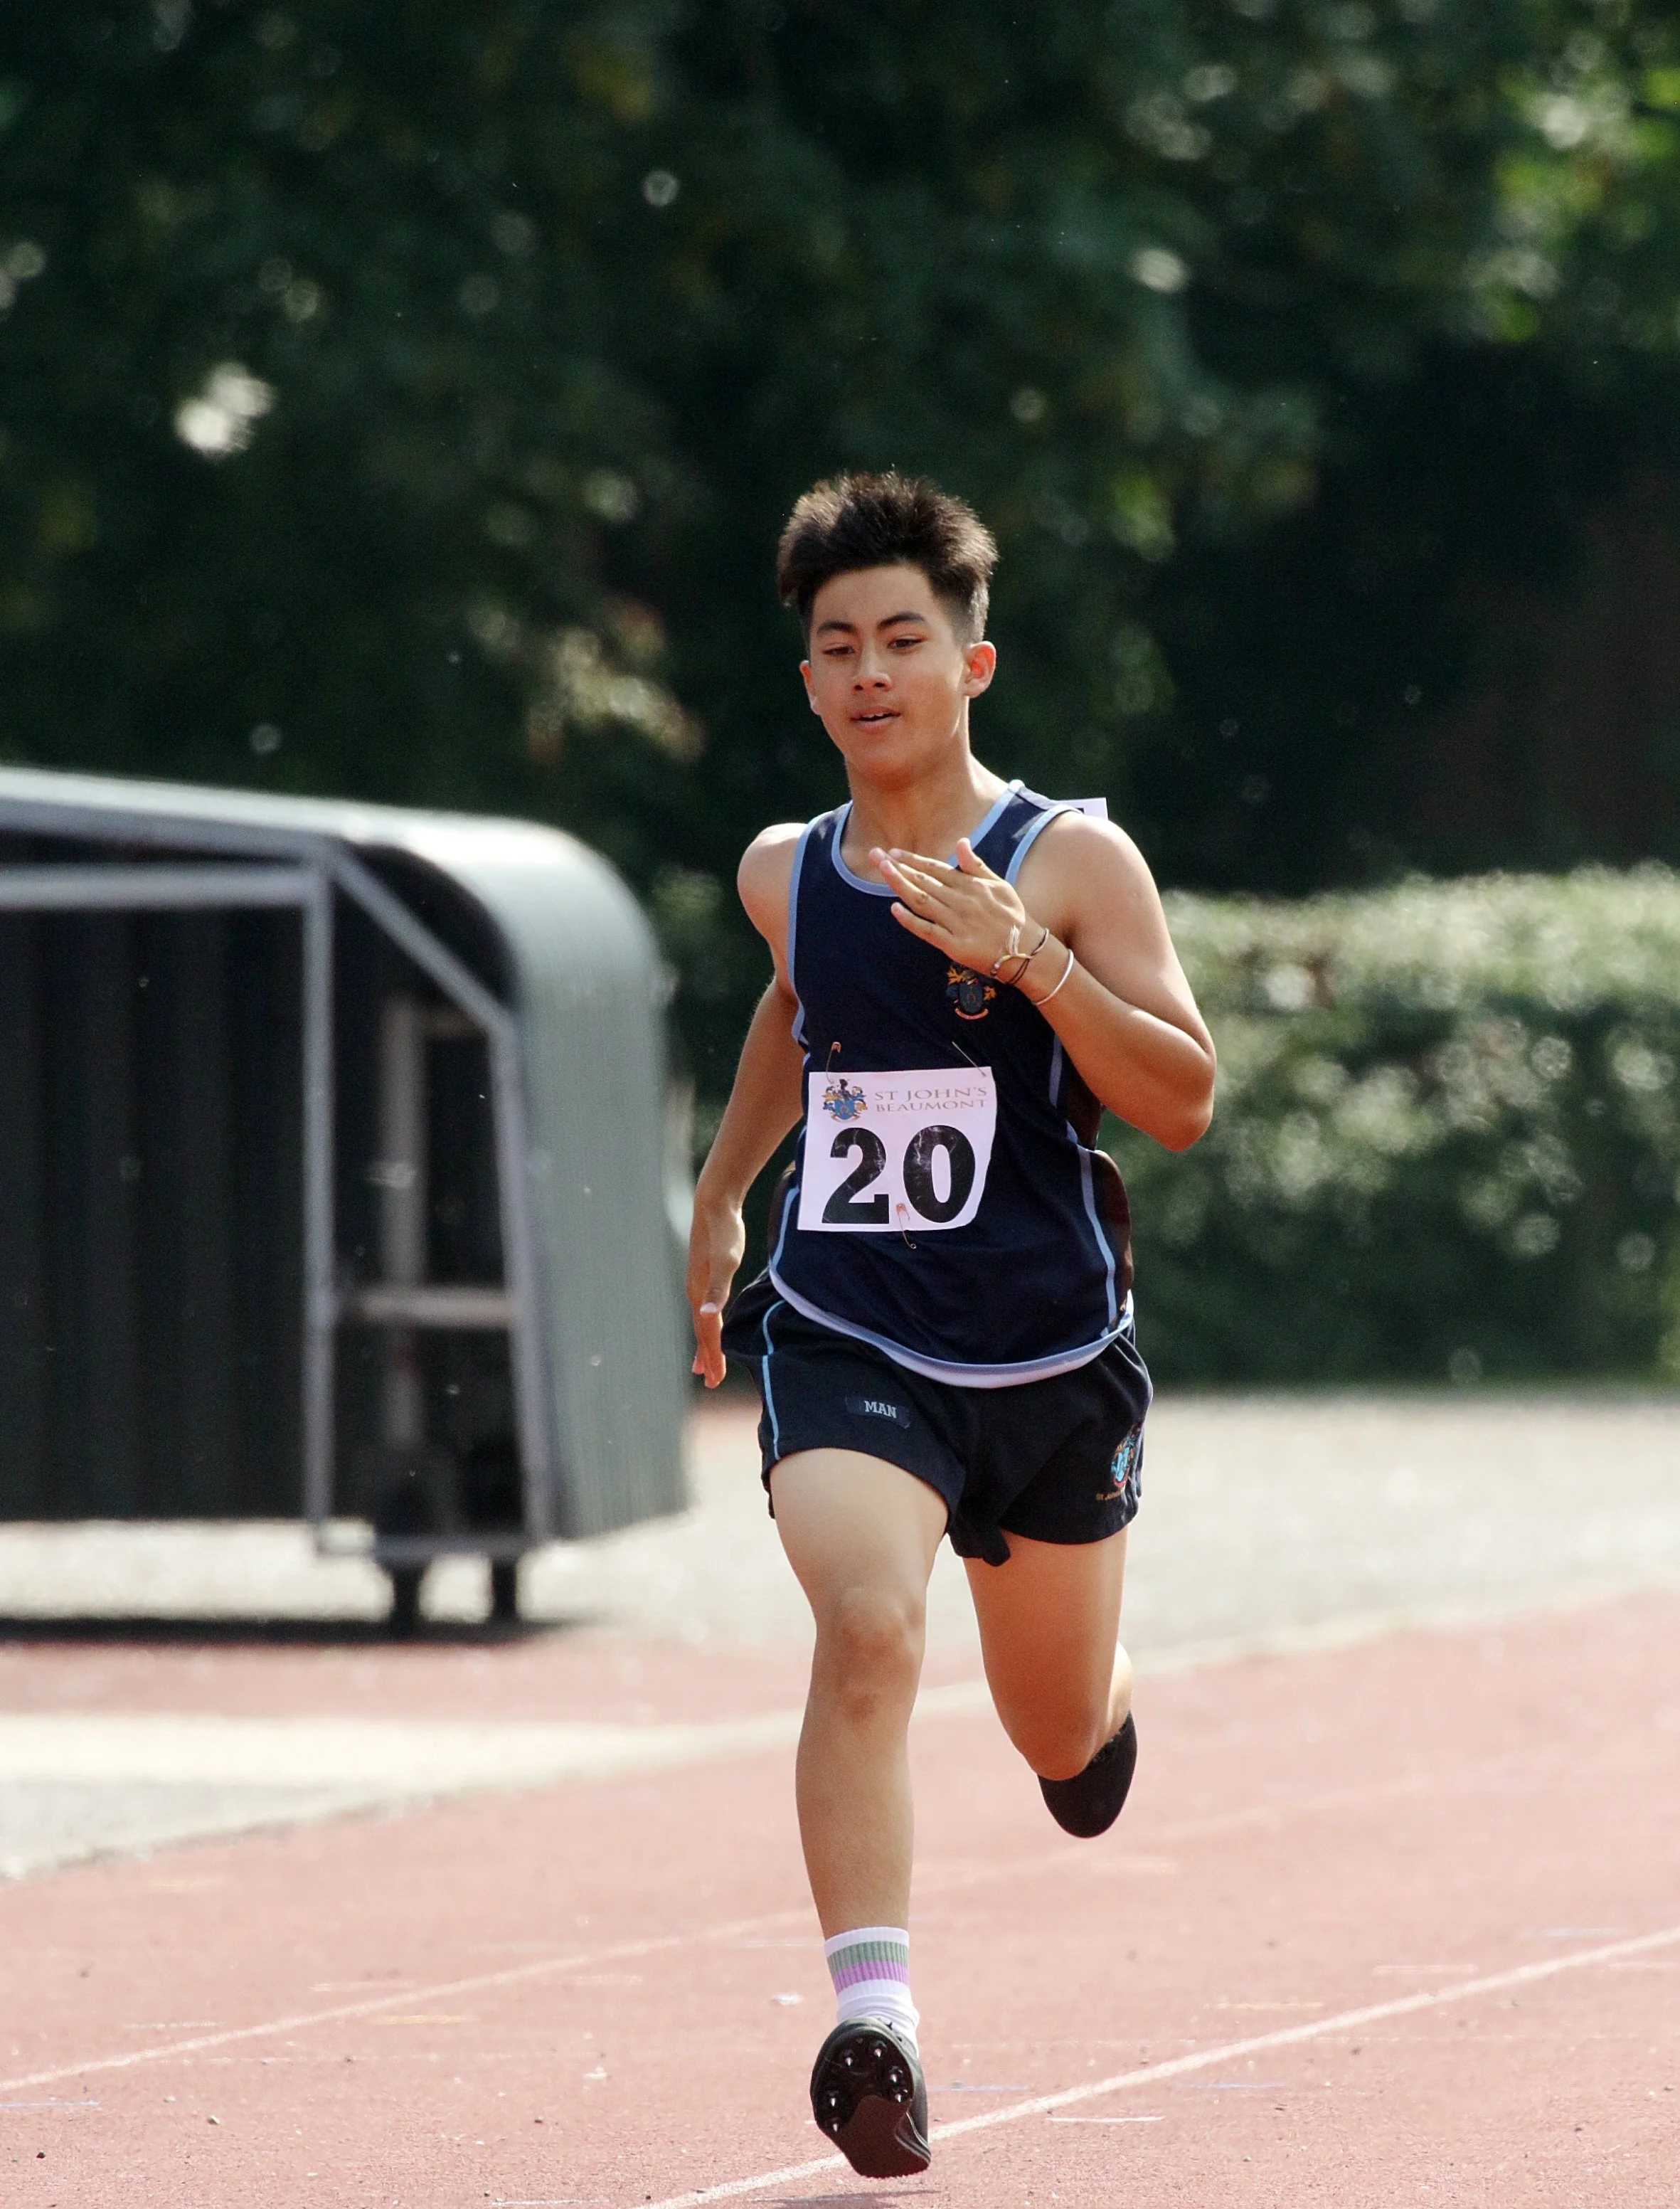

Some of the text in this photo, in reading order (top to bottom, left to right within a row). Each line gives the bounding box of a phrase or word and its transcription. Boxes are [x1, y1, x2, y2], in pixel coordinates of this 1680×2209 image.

[874, 1087, 987, 1102] ST JOHN'S
[876, 1099, 987, 1112] BEAUMONT
[822, 1125, 975, 1224] 20
[863, 1401, 896, 1419] MAN
